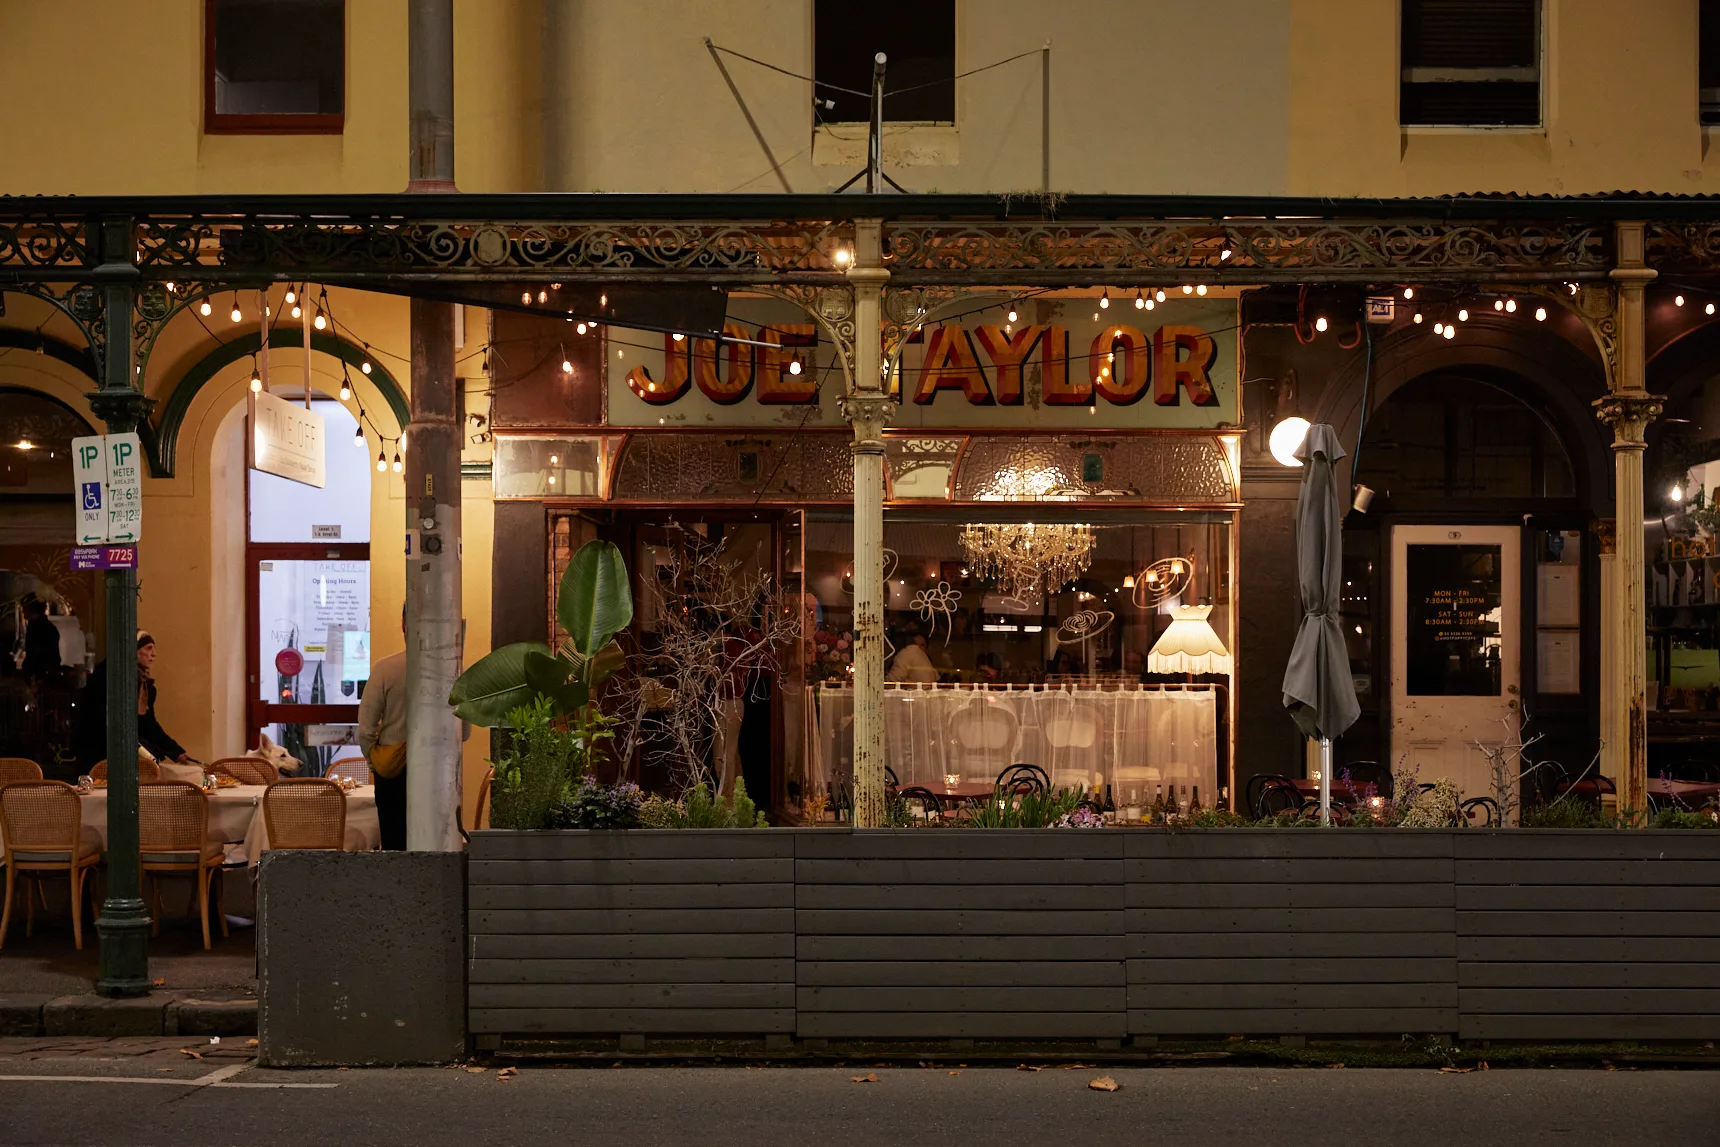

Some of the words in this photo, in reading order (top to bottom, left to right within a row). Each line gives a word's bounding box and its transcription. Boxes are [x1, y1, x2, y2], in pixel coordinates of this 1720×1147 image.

[625, 323, 820, 406] JOE
[298, 421, 316, 452] OFF
[79, 445, 99, 470] 1P
[112, 442, 133, 467] 1P
[113, 467, 135, 477] METER
[84, 512, 100, 521] ONLY
[109, 549, 133, 561] 7725
